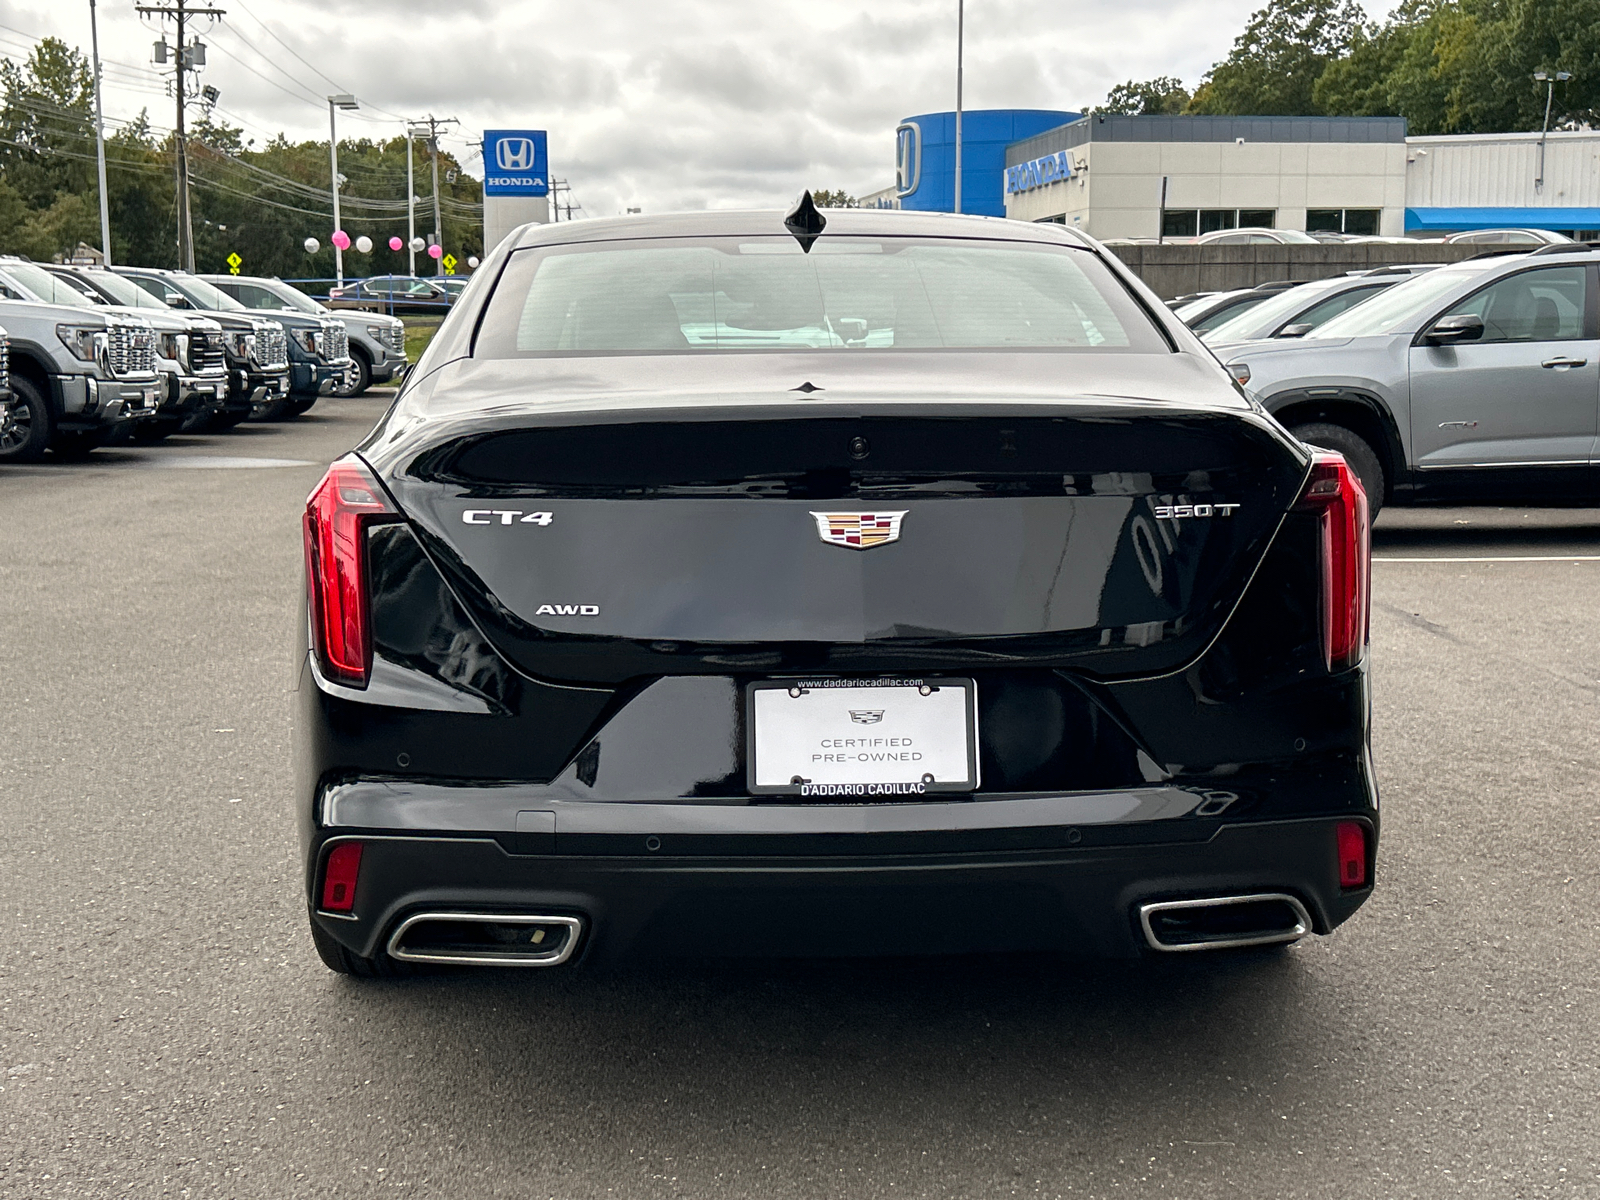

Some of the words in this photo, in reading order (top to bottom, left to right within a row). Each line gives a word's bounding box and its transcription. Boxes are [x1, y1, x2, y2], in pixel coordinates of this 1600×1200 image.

[1007, 151, 1071, 194] HONDA
[487, 177, 545, 186] HONDA
[1154, 503, 1241, 519] 350T
[462, 509, 553, 527] CT4
[535, 604, 600, 615] AWD
[797, 678, 924, 688] www.daddariocadillac.com
[820, 738, 913, 748] CERTIFIED
[812, 752, 923, 763] PRE-OWNED
[801, 784, 864, 796] D'ADDARIO
[867, 783, 926, 795] CADILLAC
